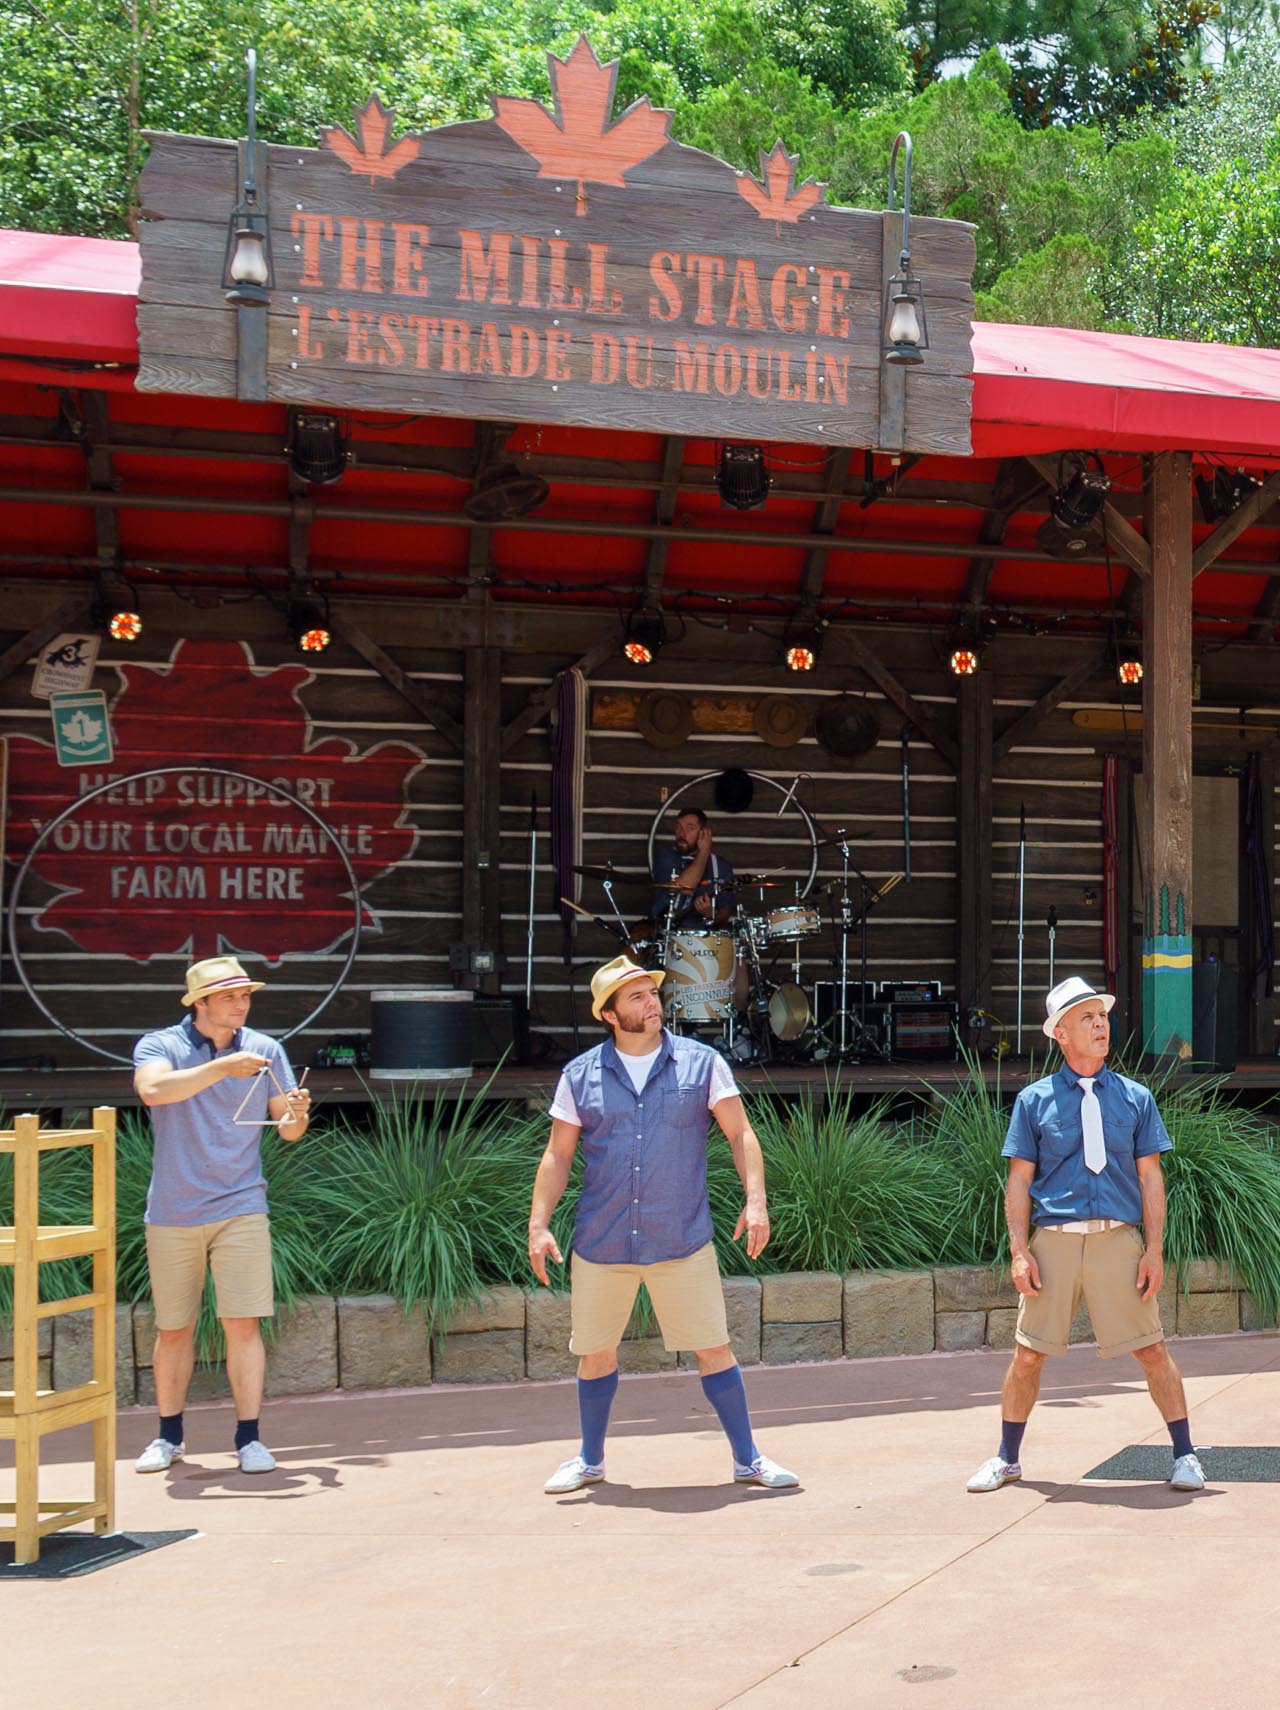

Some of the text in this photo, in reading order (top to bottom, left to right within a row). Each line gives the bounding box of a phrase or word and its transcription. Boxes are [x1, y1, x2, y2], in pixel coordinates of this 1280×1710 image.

[289, 211, 850, 338] THE MILL STAGE
[294, 304, 850, 405] L'ESTRADE DU MOULIN
[61, 645, 77, 662] 3
[76, 719, 86, 738] 1
[78, 773, 335, 808] HELP SUPPORT
[30, 818, 373, 855] YOUR LOCAL MAPLE
[110, 865, 305, 900] FARM HERE
